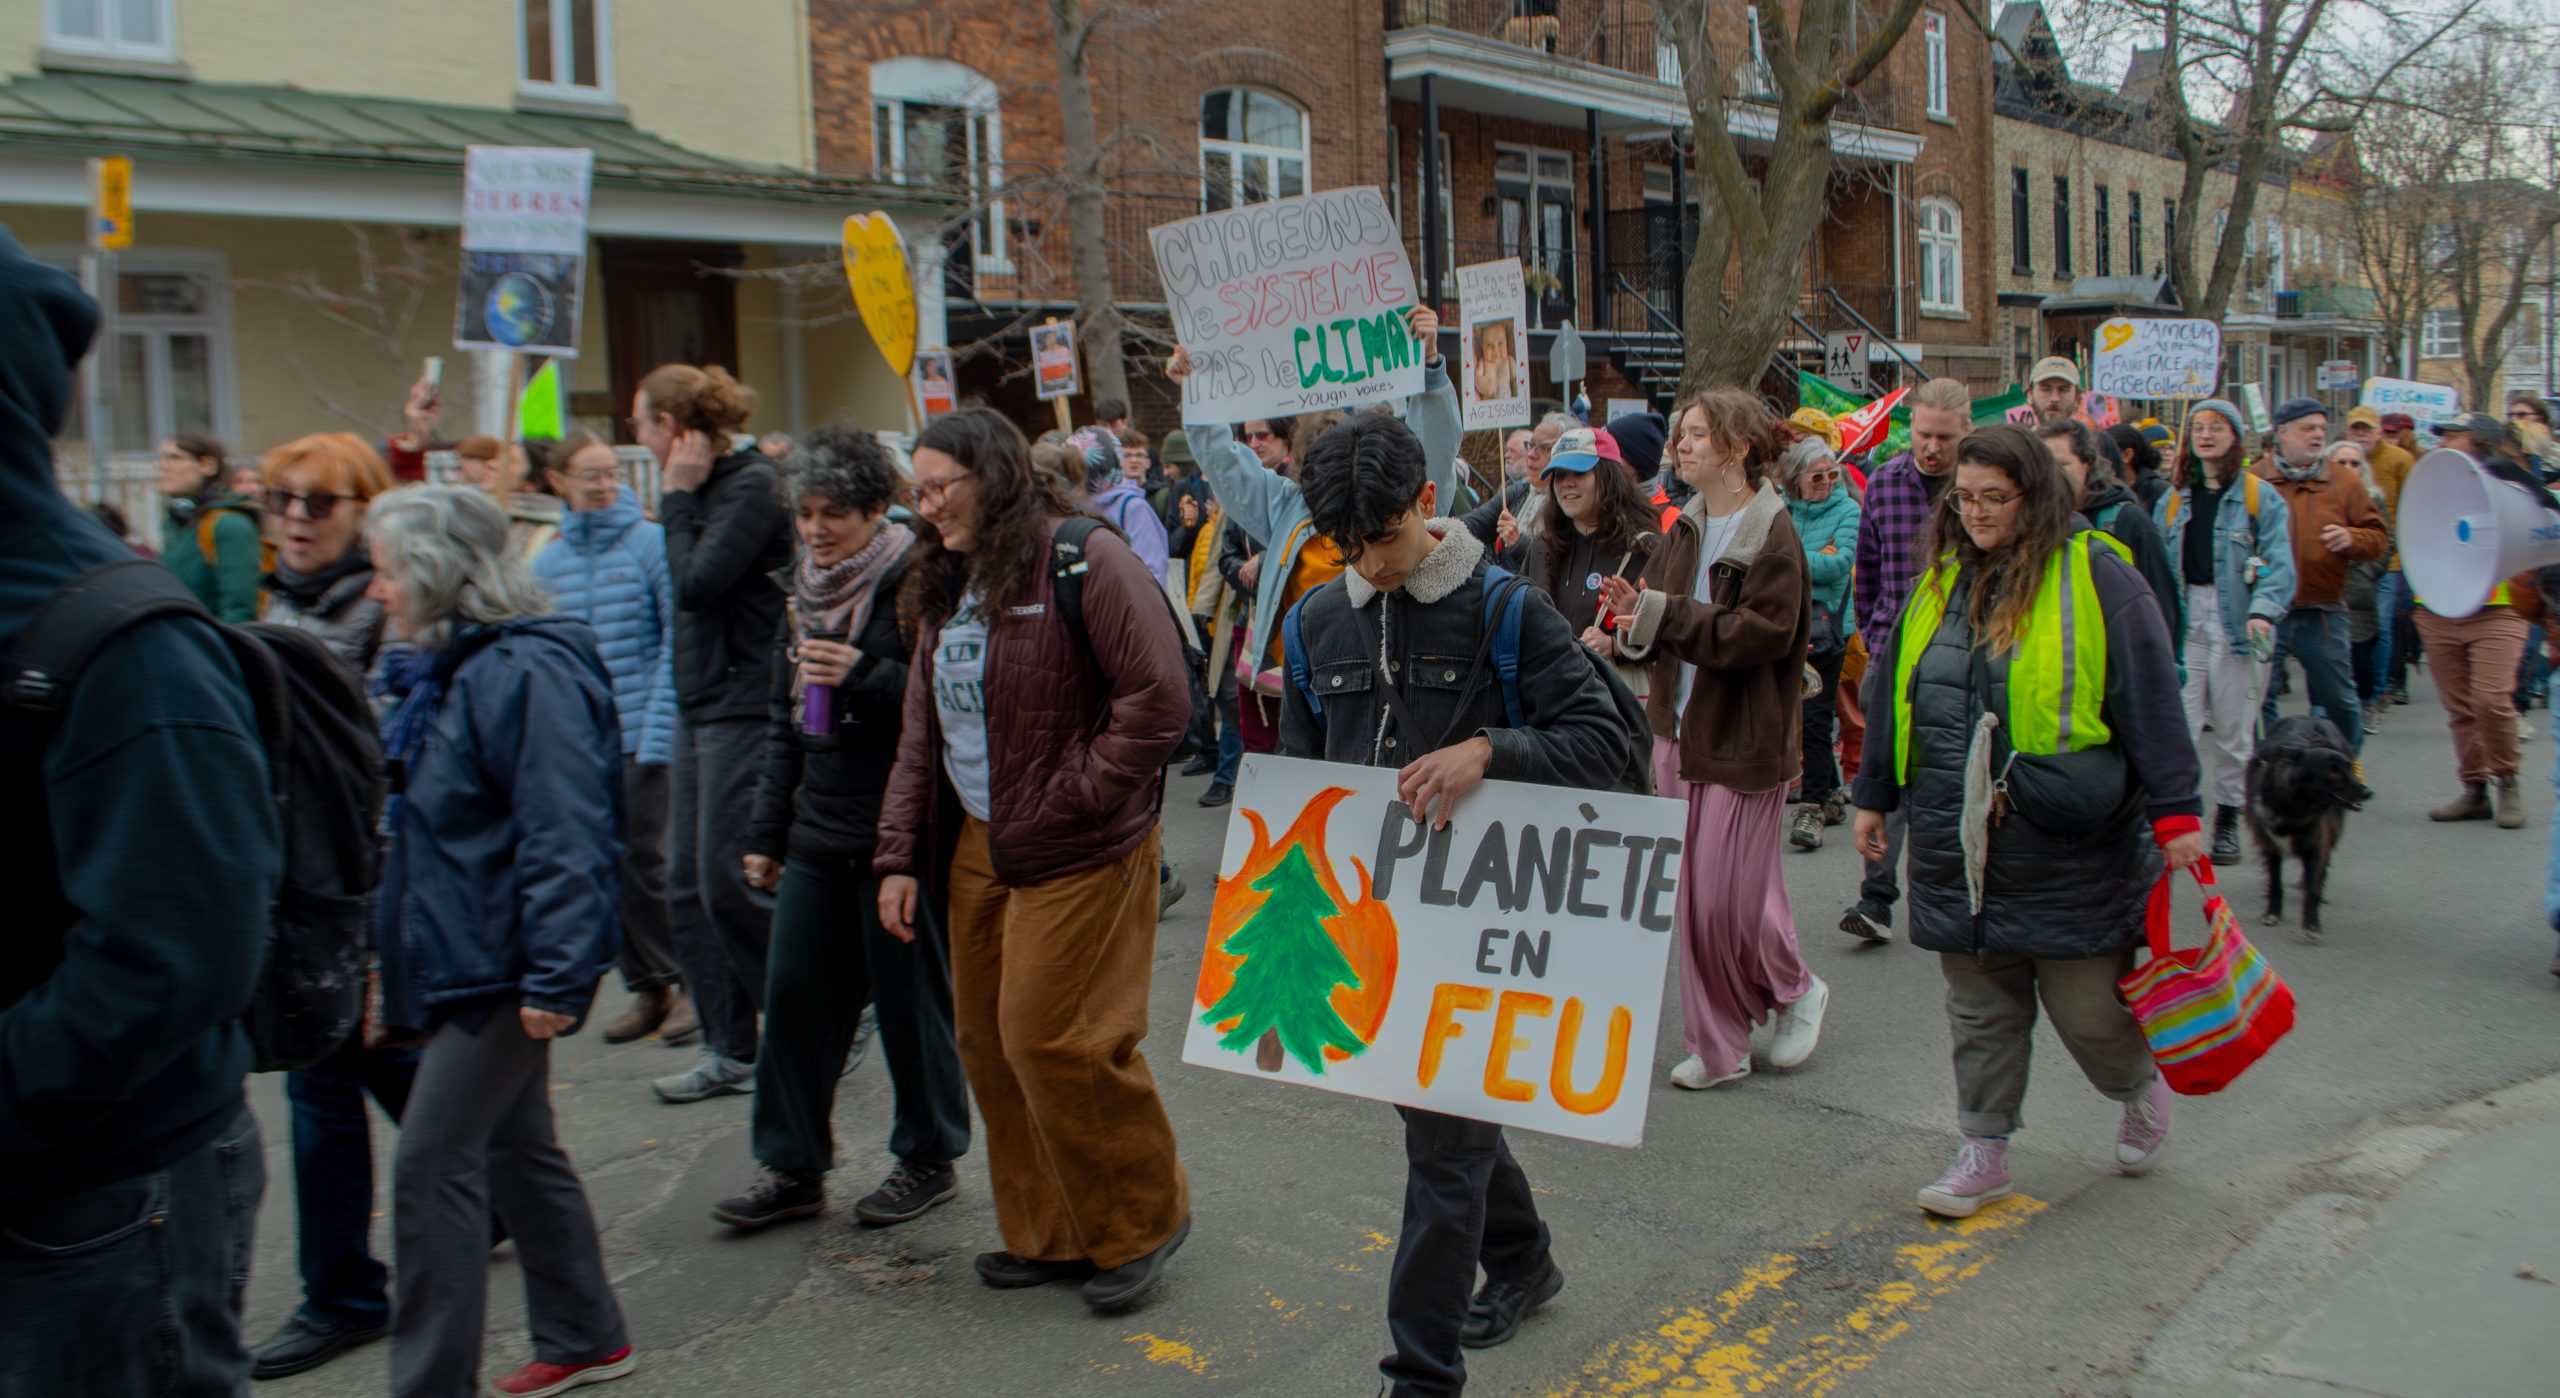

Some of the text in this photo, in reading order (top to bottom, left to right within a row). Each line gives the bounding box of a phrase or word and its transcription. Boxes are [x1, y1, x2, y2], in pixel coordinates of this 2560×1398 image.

[1156, 189, 1391, 297] CHAGEONS
[1177, 251, 1406, 344] le SYSTEME
[1187, 304, 1422, 405] PAS le CLIMAT
[1356, 381, 1395, 398] voices
[2147, 353, 2182, 372] FACE
[1372, 801, 1685, 932] PLANÈTE
[1475, 928, 1551, 978] EN
[1417, 982, 1632, 1115] FEU
